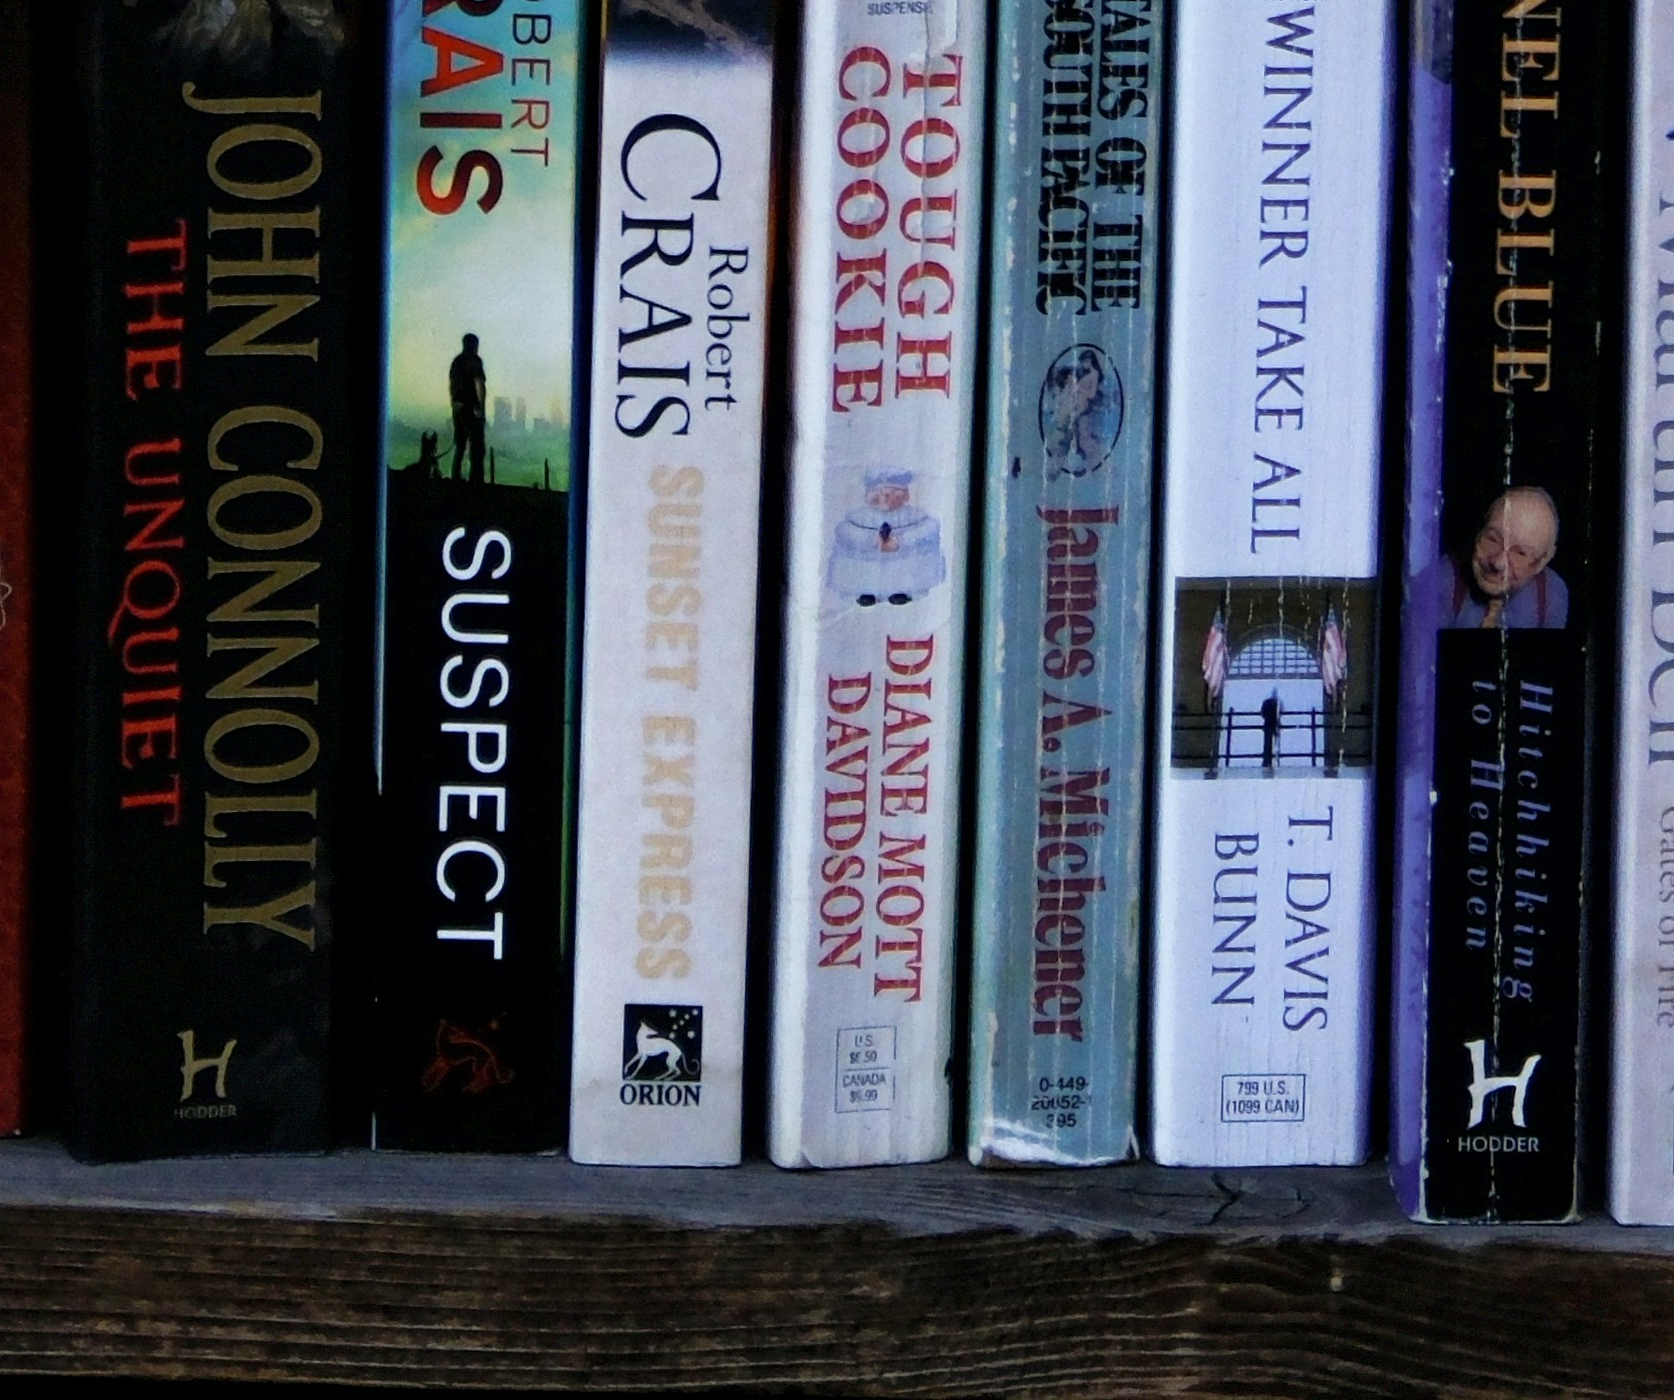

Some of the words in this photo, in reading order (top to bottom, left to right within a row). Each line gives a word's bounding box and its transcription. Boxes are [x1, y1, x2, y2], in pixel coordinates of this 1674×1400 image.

[180, 79, 324, 363] JOHN
[830, 46, 892, 414] COOKIE
[895, 52, 968, 400] TOUGH
[1035, 140, 1093, 317] PACIFIC
[1258, 4, 1316, 271] WINNER
[125, 215, 191, 400] THE
[614, 112, 722, 439] CRAIS
[1252, 285, 1308, 435] TAKE
[1490, 168, 1558, 396] BLUE
[643, 463, 705, 693] SUNSET
[1035, 504, 1120, 682] James
[1249, 451, 1303, 556] ALL
[105, 435, 185, 826] UNQUIET
[202, 403, 324, 952] CONNOLLY
[880, 632, 935, 820] DIANE
[1041, 689, 1094, 753] A.
[435, 525, 514, 960] SUSPECT
[1285, 805, 1335, 847] T.
[1500, 678, 1555, 1004] Hitchhiking
[633, 714, 698, 982] EXPRESS
[871, 826, 928, 1004] MOTT
[1032, 766, 1111, 1043] Michener
[1282, 867, 1332, 1032] DAVIS
[172, 1103, 237, 1120] HODDER
[618, 1081, 701, 1107] ORION
[1457, 1135, 1540, 1154] HODDER
